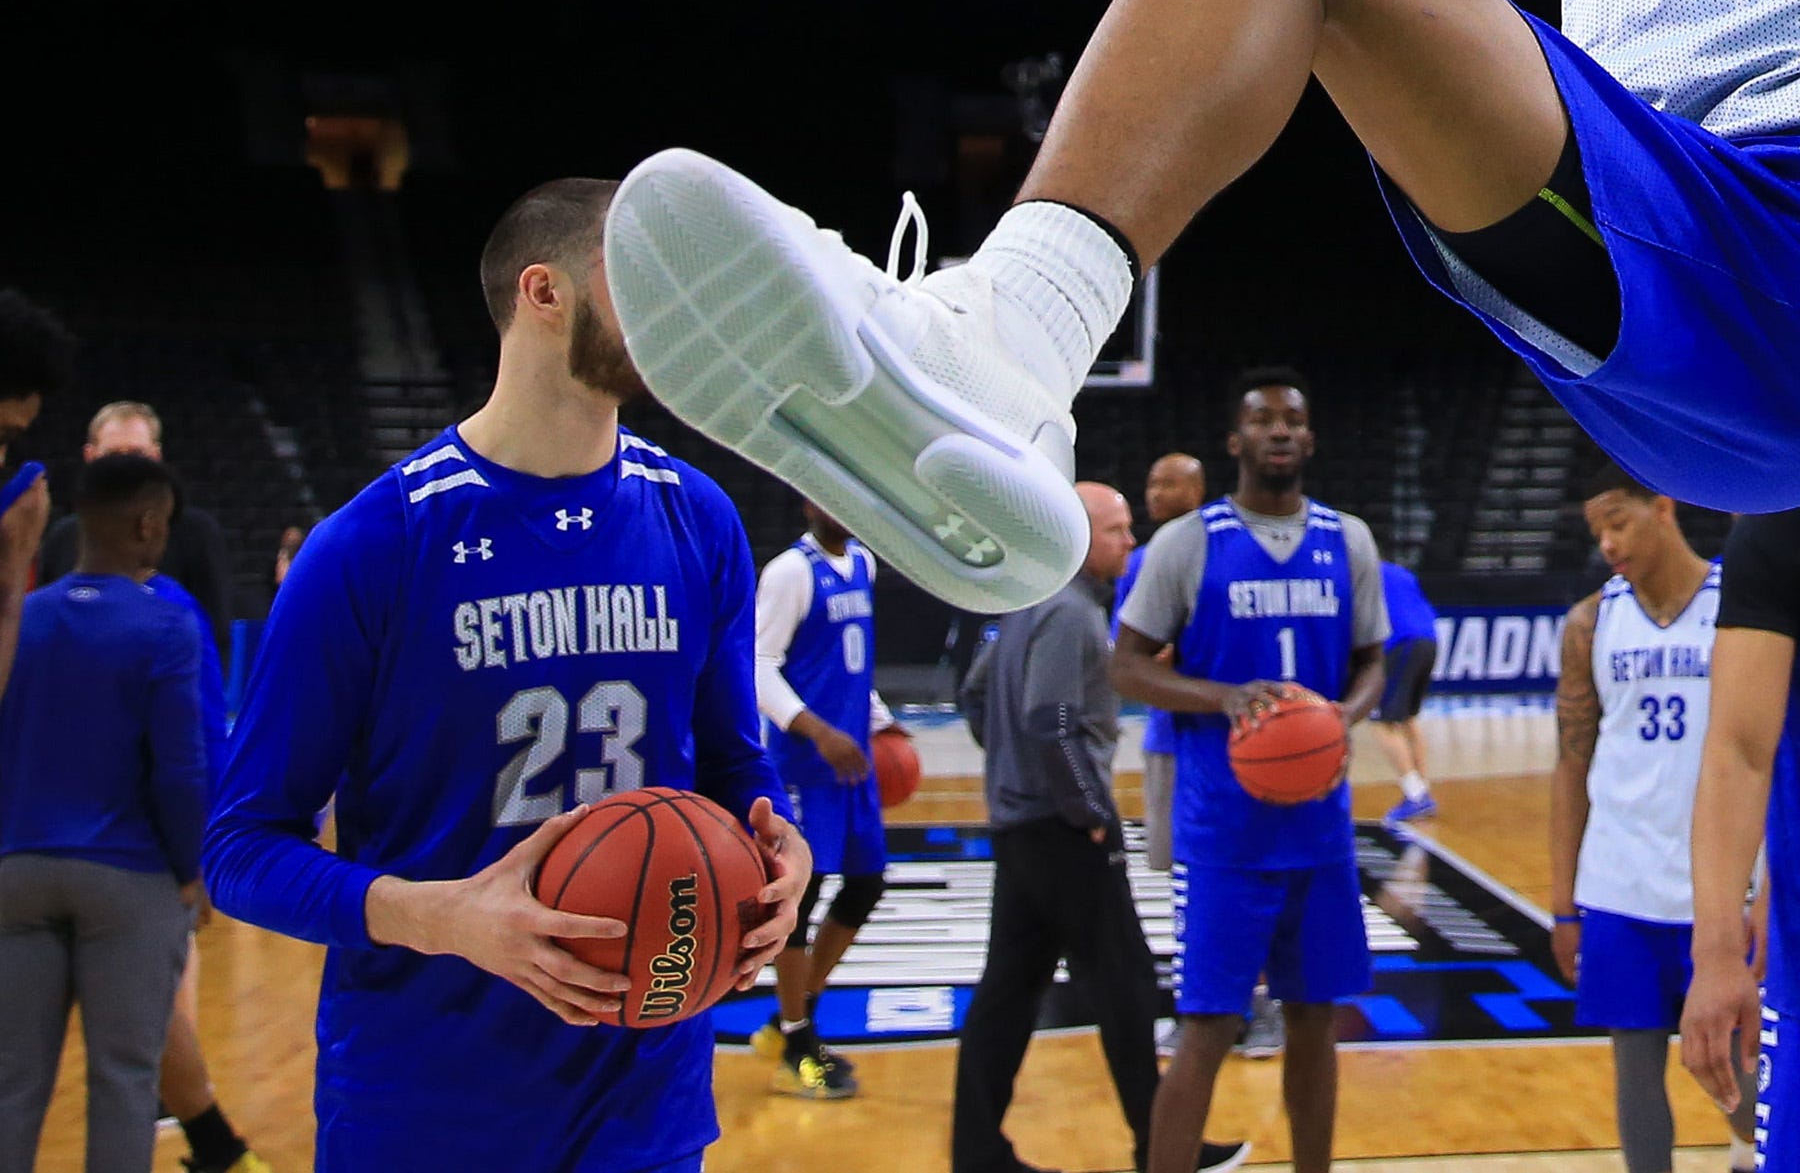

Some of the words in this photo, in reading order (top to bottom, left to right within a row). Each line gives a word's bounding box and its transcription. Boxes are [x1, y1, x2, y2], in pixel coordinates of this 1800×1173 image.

[453, 589, 580, 671] SETON
[583, 585, 679, 655] HALL
[842, 623, 866, 675] 0
[1276, 627, 1296, 679] 1
[1430, 615, 1567, 681] ADN
[1638, 695, 1686, 741] 33
[493, 678, 647, 826] 23
[637, 872, 698, 1021] Wilson
